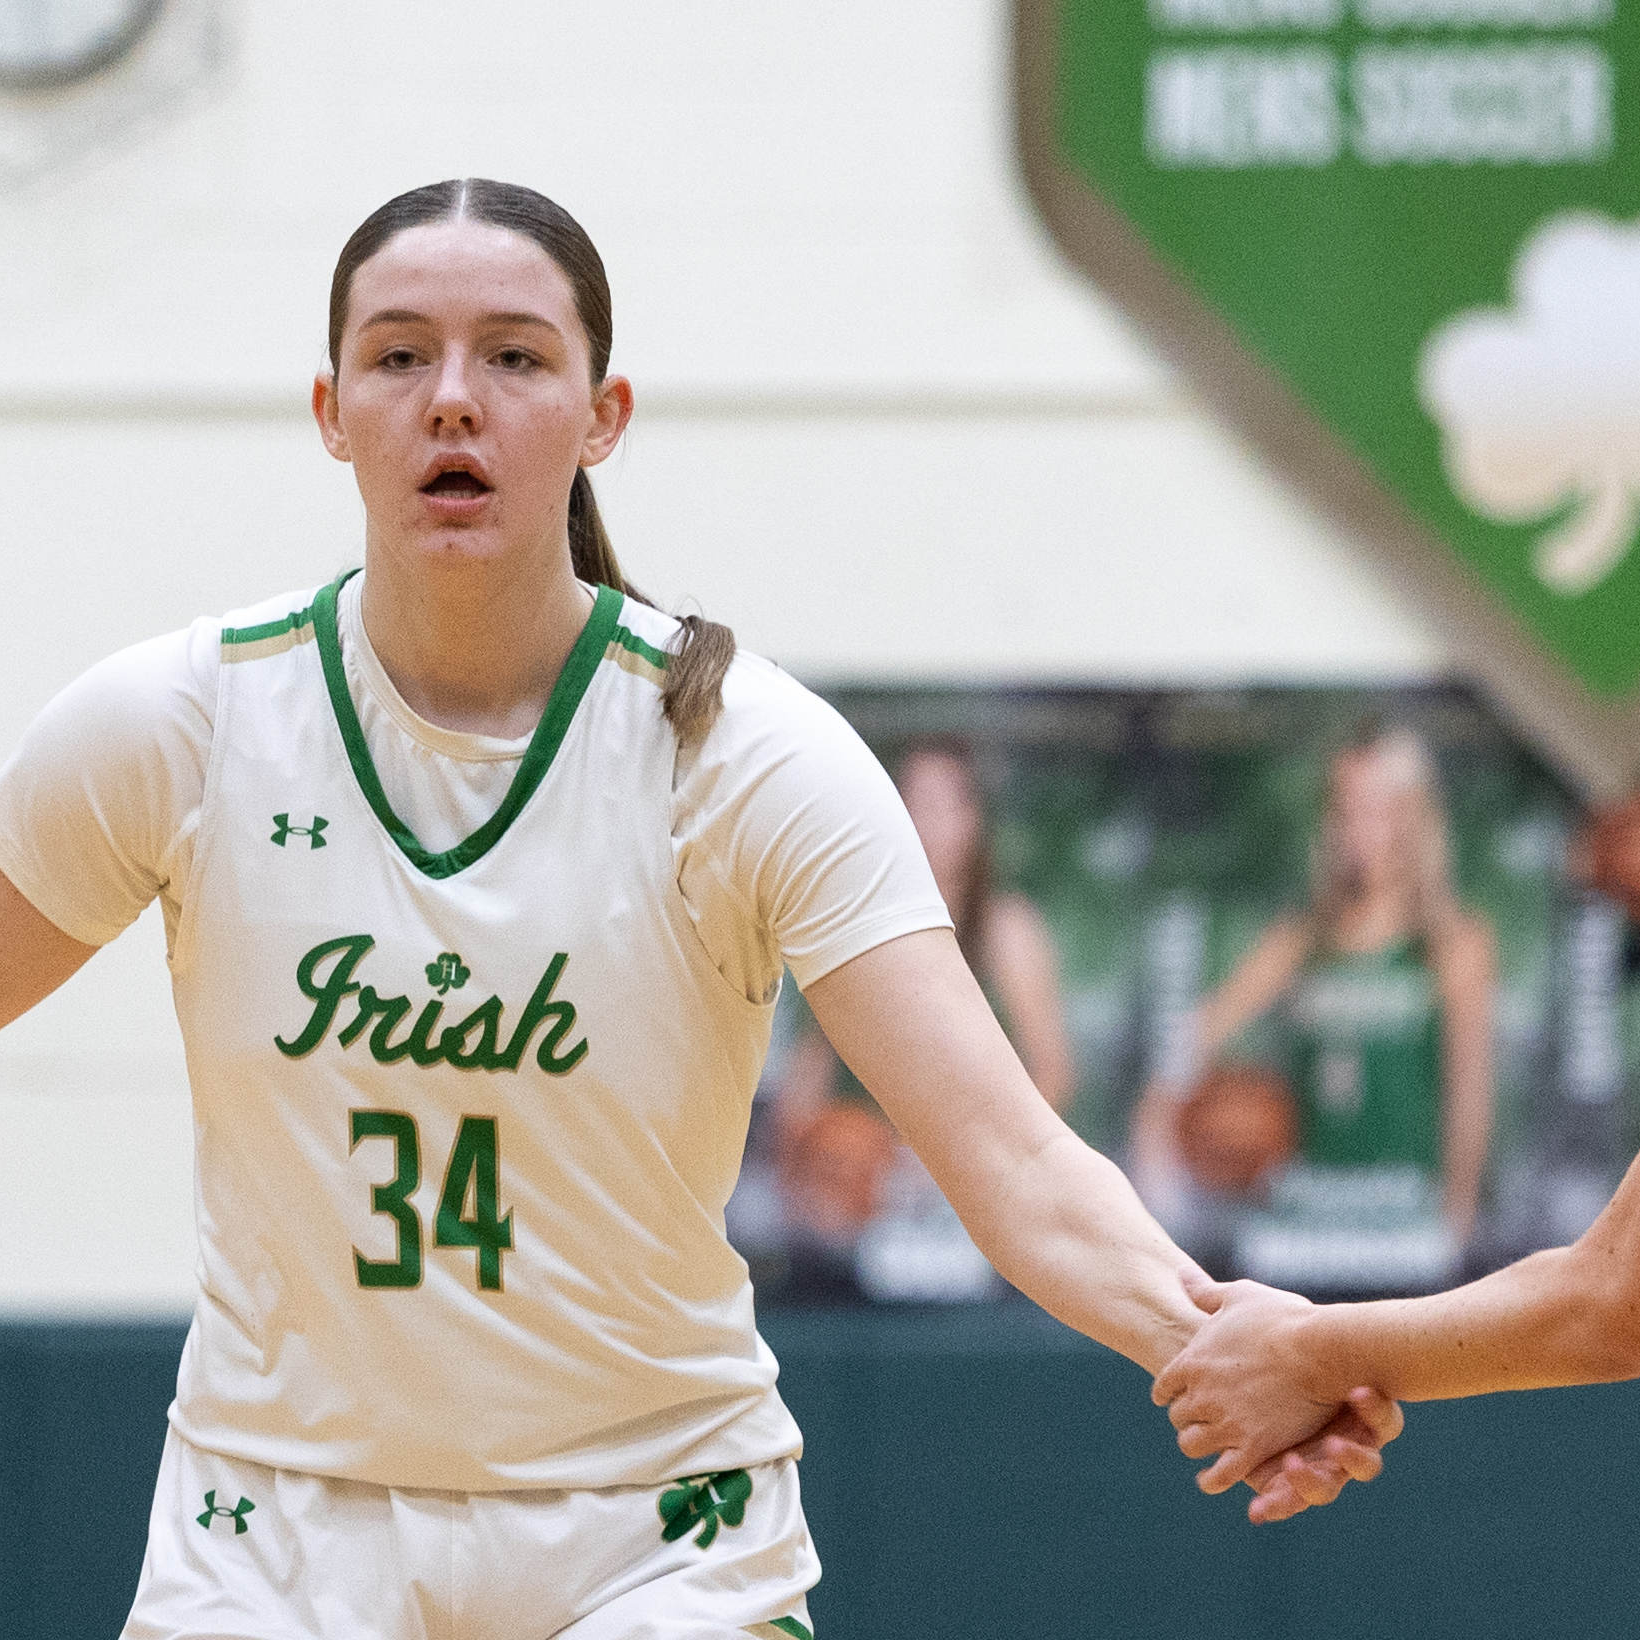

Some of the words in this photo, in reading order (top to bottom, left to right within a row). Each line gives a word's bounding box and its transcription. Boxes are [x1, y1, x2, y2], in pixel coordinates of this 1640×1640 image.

[1145, 42, 1341, 168] MENS
[1349, 40, 1615, 166] SOCCER
[274, 934, 589, 1076] Irish
[348, 1108, 516, 1293] 34
